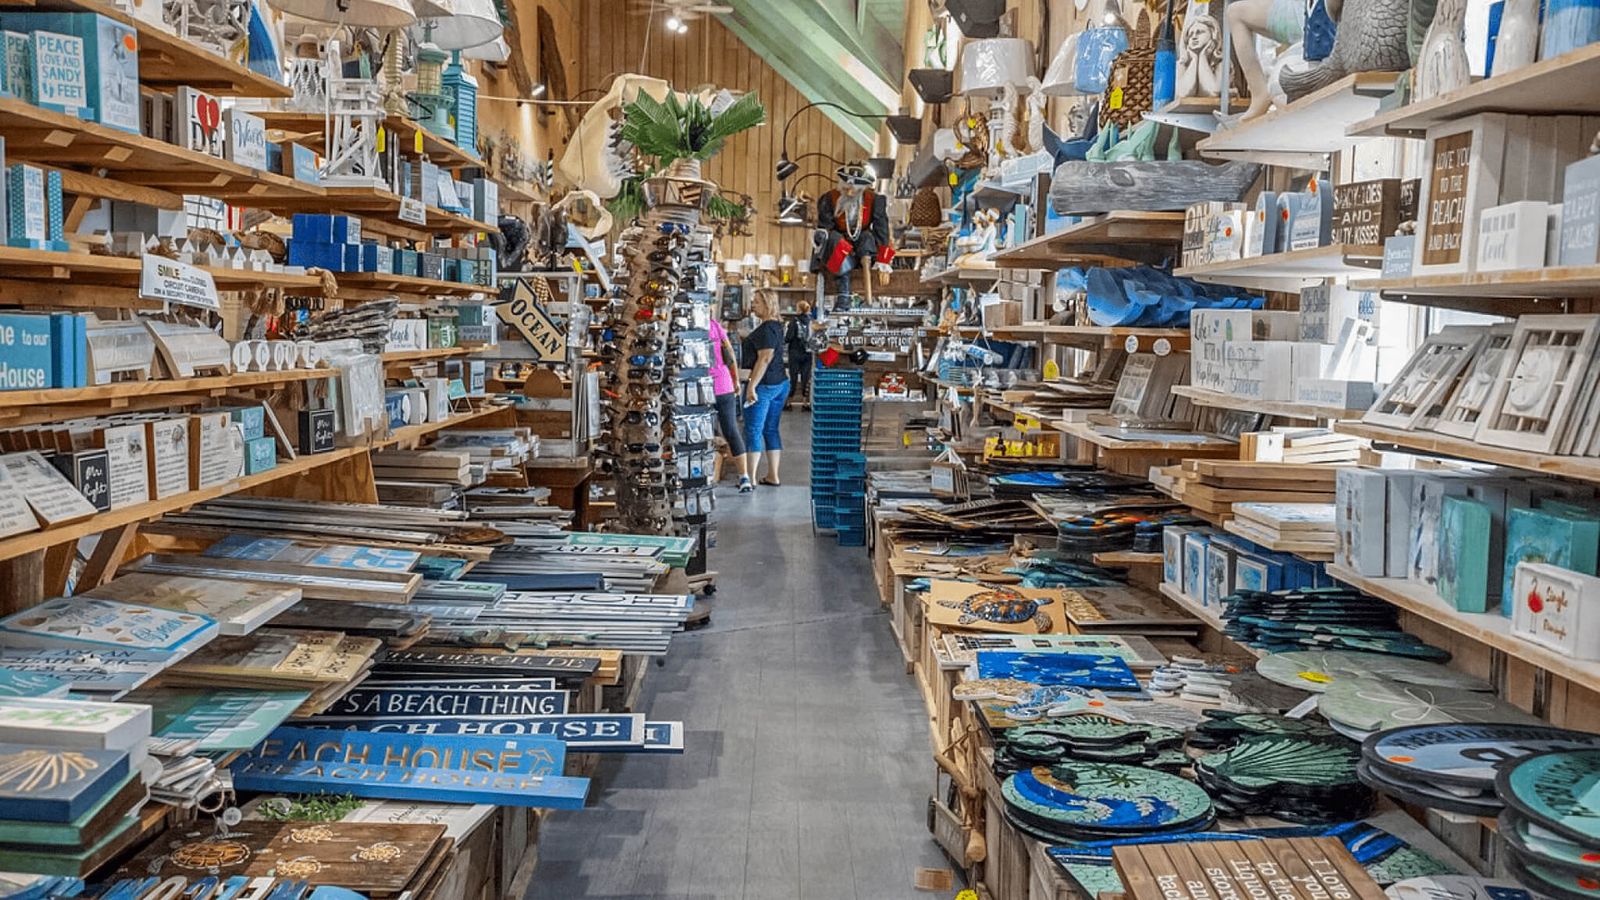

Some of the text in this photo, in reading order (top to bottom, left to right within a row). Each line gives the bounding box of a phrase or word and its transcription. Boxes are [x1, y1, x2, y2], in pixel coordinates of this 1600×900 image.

[39, 36, 80, 57] PEACE
[40, 54, 80, 69] LOVE AND
[41, 65, 82, 82] SANDY
[57, 83, 83, 99] FEET
[1436, 150, 1455, 171] LOVE
[1450, 174, 1463, 193] THE
[1341, 209, 1372, 226] AND
[1432, 197, 1466, 226] BEACH
[157, 264, 181, 280] SMILE
[510, 298, 562, 355] OCEAN
[22, 329, 32, 346] to
[33, 334, 50, 346] our
[0, 362, 45, 388] House
[546, 657, 586, 669] DE
[362, 691, 381, 714] A
[387, 693, 470, 715] BEACH
[479, 693, 556, 715] THING
[244, 739, 523, 774] EACH HOUSE
[1257, 860, 1277, 877] to
[1315, 869, 1351, 899] love
